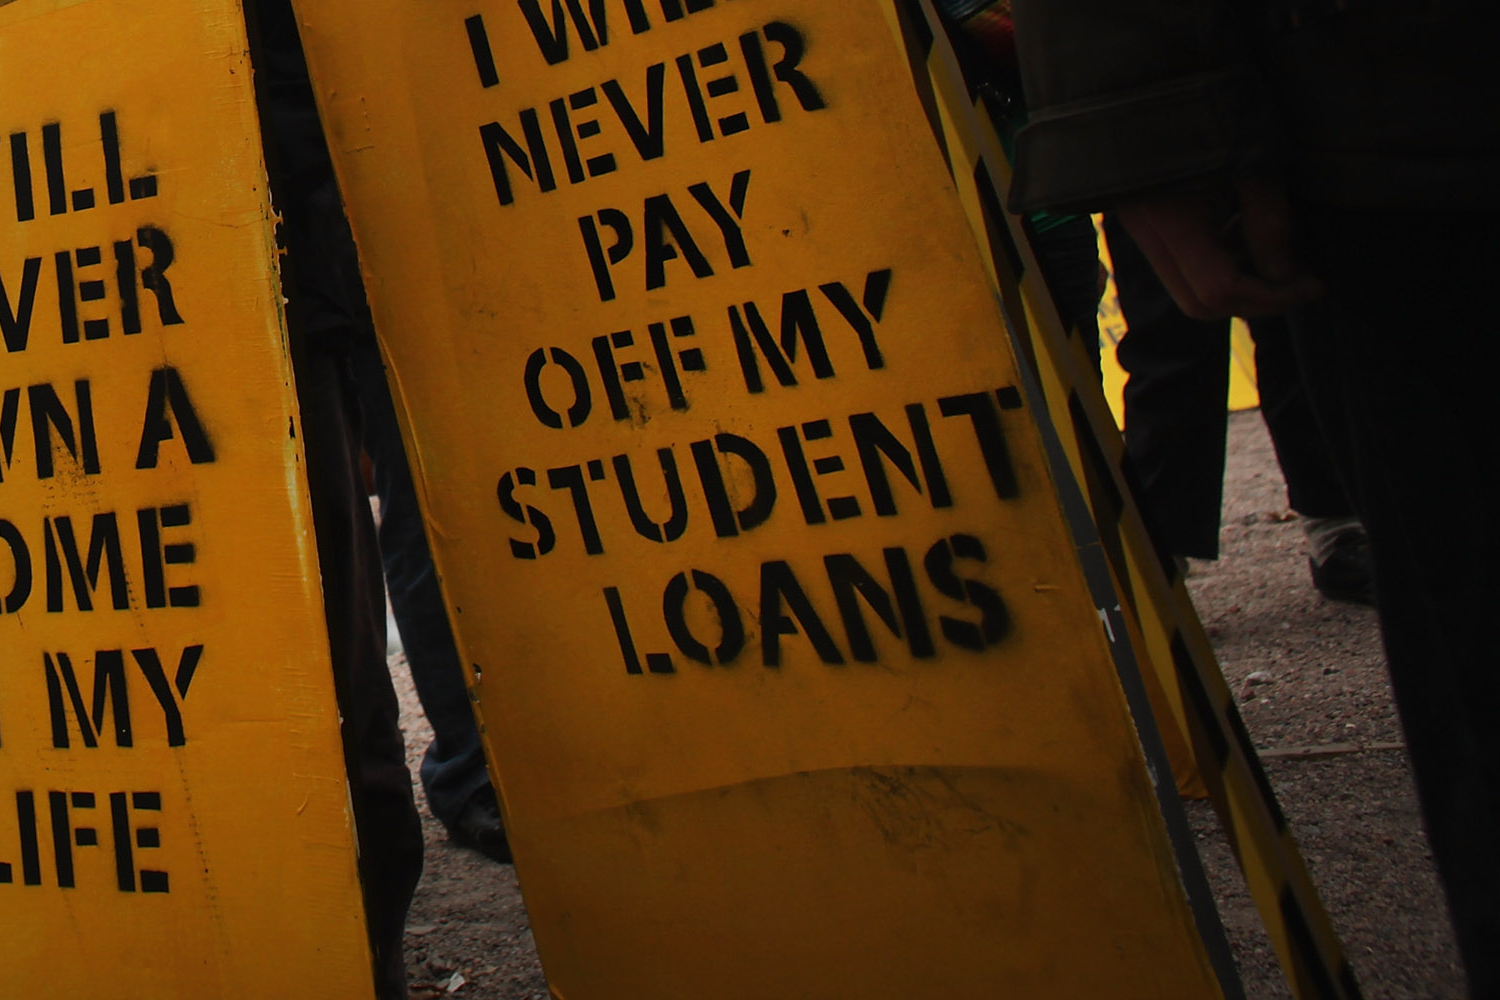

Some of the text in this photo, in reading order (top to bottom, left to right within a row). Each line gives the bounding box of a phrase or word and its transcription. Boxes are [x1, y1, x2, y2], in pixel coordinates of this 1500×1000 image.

[465, 14, 499, 89] I
[479, 20, 828, 207] NEVER
[578, 169, 752, 302] PAY
[135, 366, 216, 470] A
[524, 268, 893, 430] OFF MY
[497, 385, 1024, 560] STUDENT
[602, 532, 1019, 677] LOANS
[42, 644, 205, 750] MY
